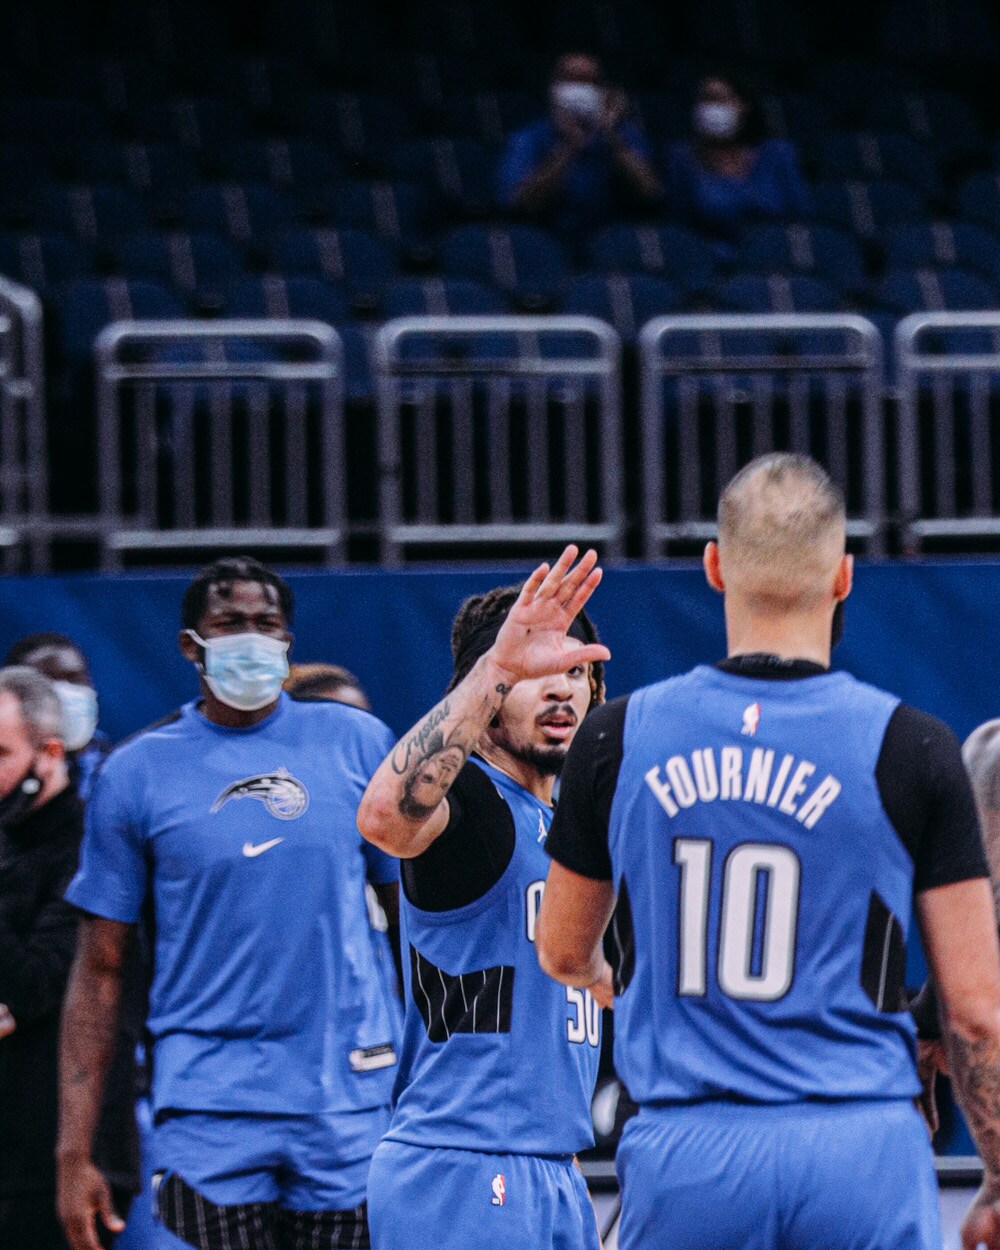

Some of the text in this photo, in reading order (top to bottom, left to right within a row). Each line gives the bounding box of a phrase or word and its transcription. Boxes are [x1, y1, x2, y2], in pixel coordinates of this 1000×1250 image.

[645, 746, 841, 829] FOURNIER
[672, 837, 802, 1002] 10
[565, 985, 602, 1047] 50
